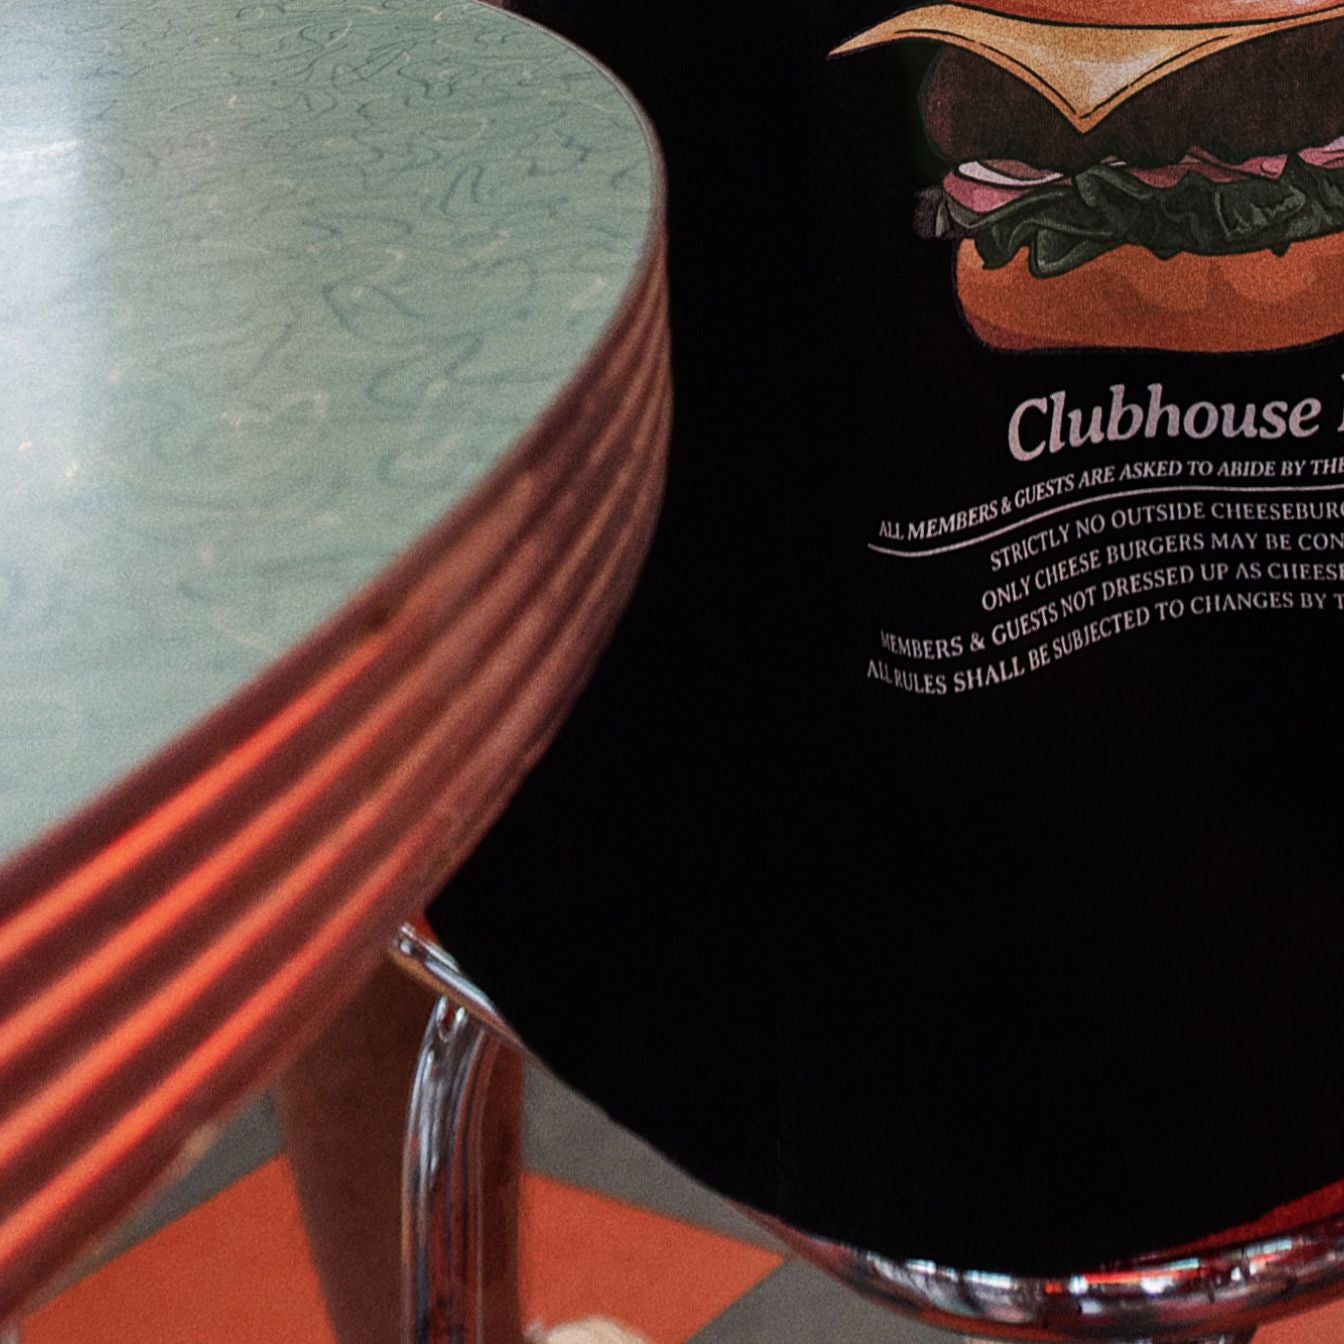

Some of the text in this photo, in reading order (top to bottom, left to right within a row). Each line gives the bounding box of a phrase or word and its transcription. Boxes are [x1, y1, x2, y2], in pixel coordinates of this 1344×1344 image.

[1008, 383, 1321, 461] Clubhouse
[879, 521, 904, 539] ALL
[908, 500, 998, 540] MEMBERS
[1001, 496, 1011, 514] &
[1015, 474, 1074, 508] GUESTS
[1078, 466, 1115, 488] ARE
[1119, 461, 1182, 480] ASKED
[1187, 461, 1213, 475] TO
[1217, 461, 1275, 476] ABIDE
[1281, 460, 1306, 476] BY
[991, 523, 1069, 571] STRICTLY
[1076, 515, 1105, 538] NO
[1111, 502, 1205, 528] OUTSIDE
[881, 632, 963, 659] MEMBERS
[970, 633, 985, 651] &
[992, 602, 1058, 645] GUESTS
[1061, 586, 1096, 617] NOT
[1102, 566, 1194, 601] DRESSED
[1201, 563, 1228, 580] UP
[1236, 563, 1261, 579] AS
[982, 575, 1030, 610] ONLY
[1035, 550, 1101, 589] CHEESE
[1107, 534, 1204, 564] BURGERS
[1212, 533, 1257, 549] MAY
[1266, 534, 1291, 550] BE
[868, 660, 891, 683] ALL
[894, 669, 947, 694] RULES
[954, 656, 1025, 692] SHALL
[1028, 644, 1050, 670] BE
[1048, 605, 1150, 659] SUBJECTED
[1155, 600, 1184, 620] TO
[1191, 592, 1293, 614] CHANGES
[1301, 593, 1326, 608] BY
